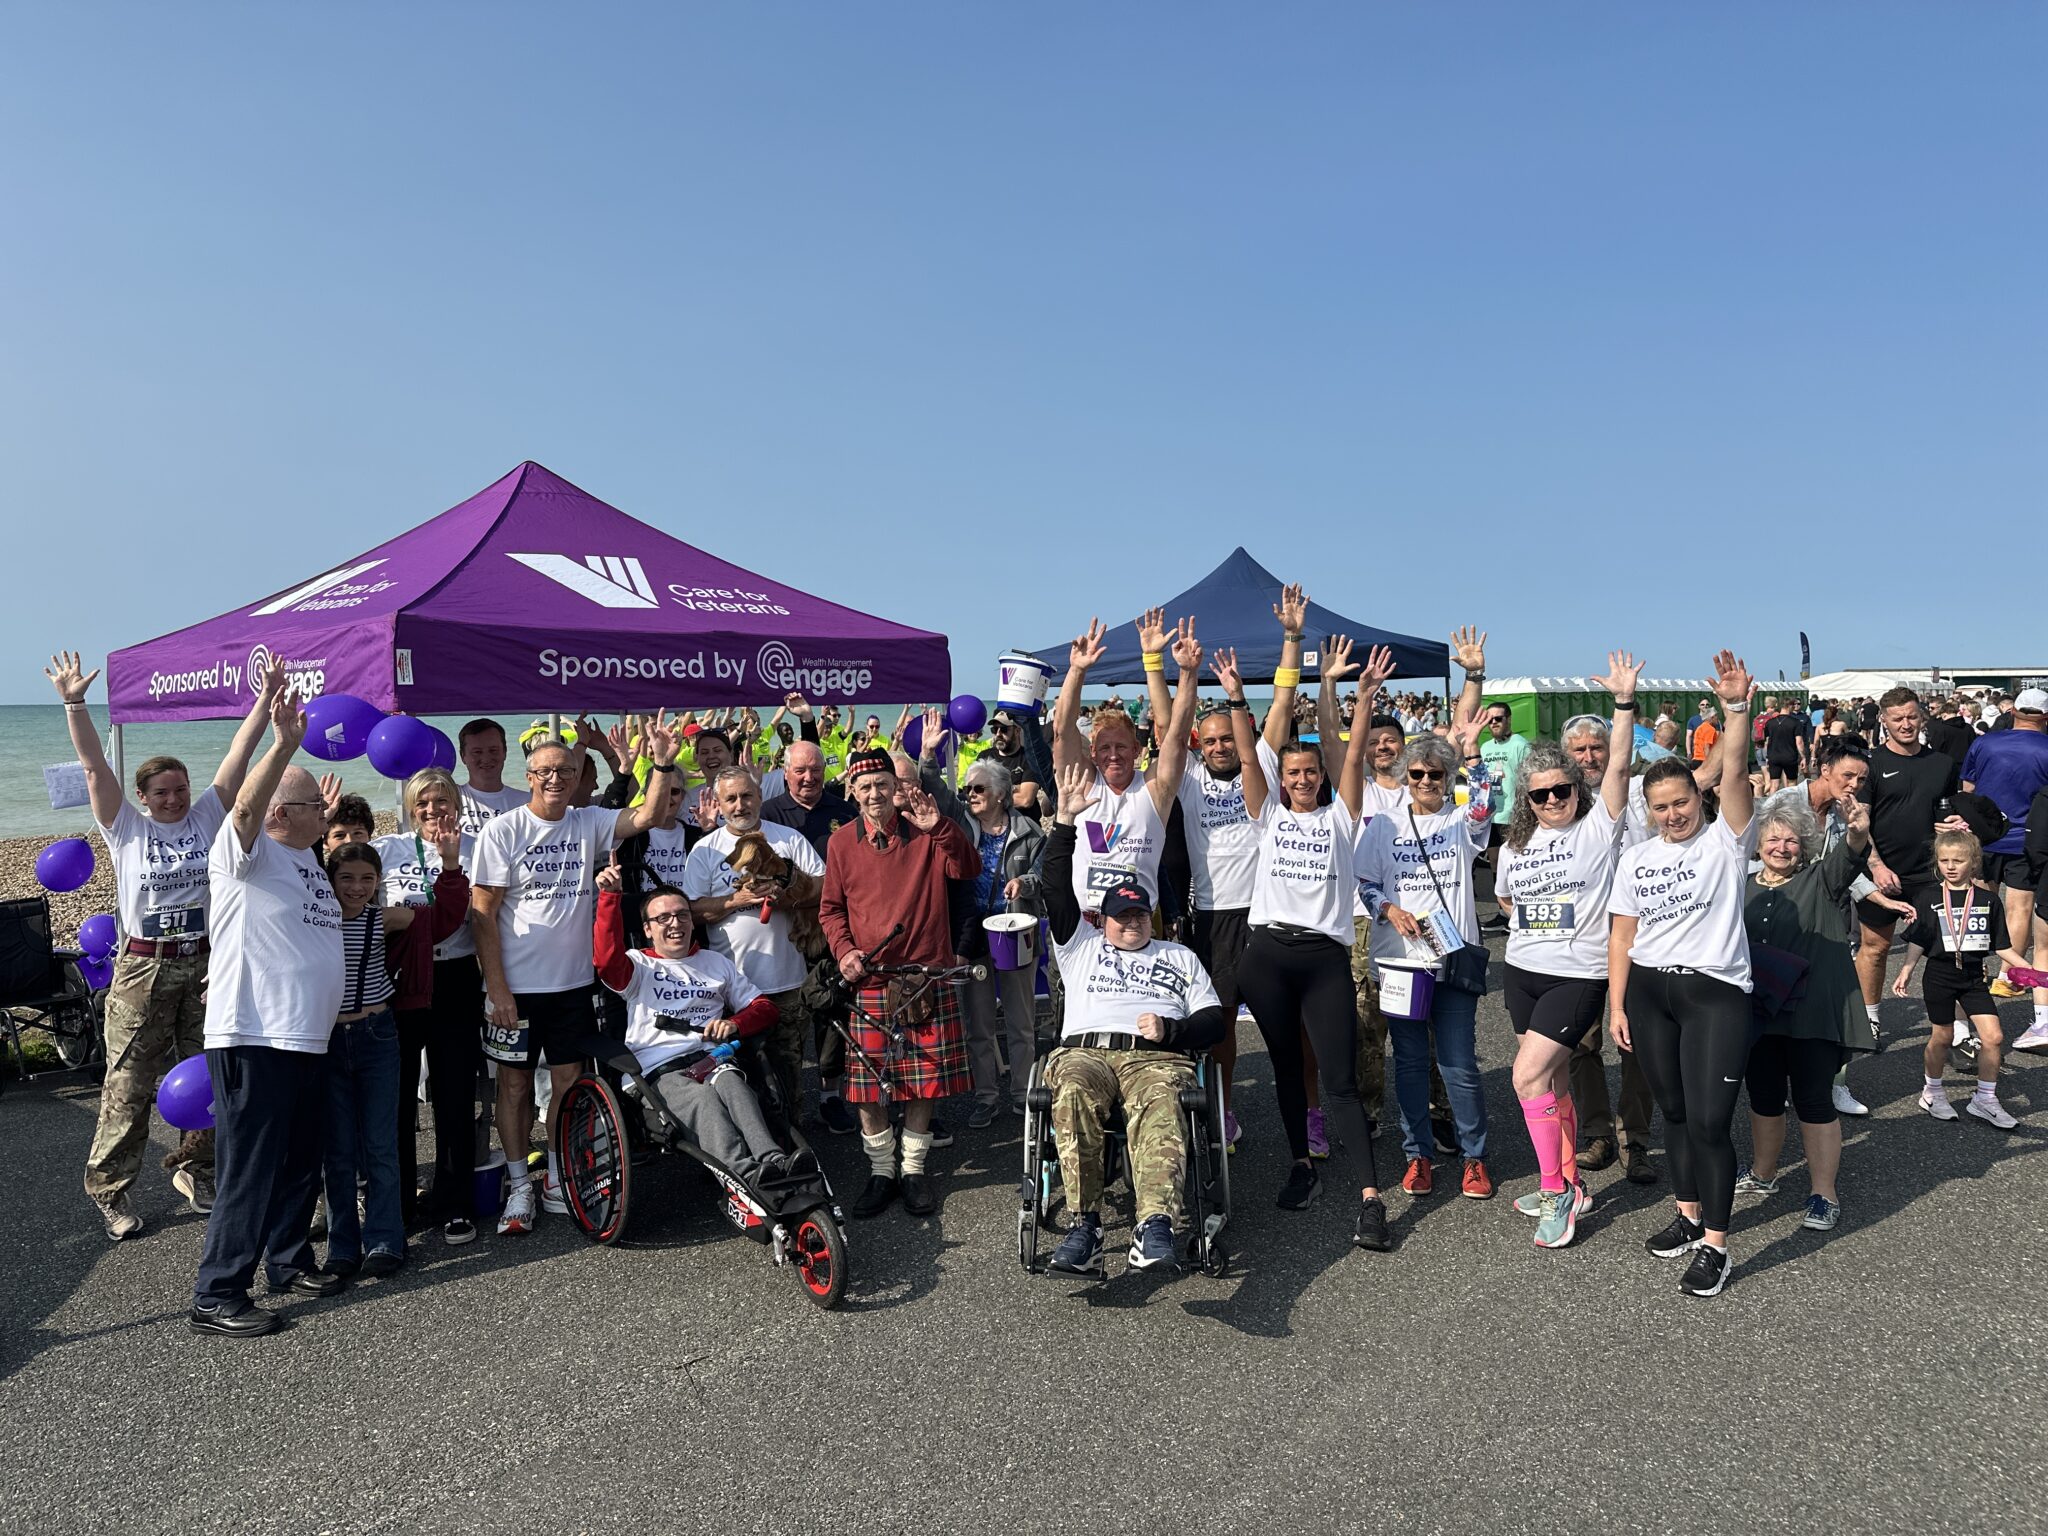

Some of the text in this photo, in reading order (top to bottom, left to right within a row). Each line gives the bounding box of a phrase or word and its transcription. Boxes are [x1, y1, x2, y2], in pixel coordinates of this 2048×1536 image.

[322, 579, 399, 597] Care for
[668, 583, 771, 602] Care for
[291, 596, 370, 612] Veterans
[671, 596, 790, 616] Veterans
[293, 657, 327, 671] Management
[538, 649, 747, 686] Sponsored by
[801, 657, 873, 669] Wealth Management
[148, 660, 242, 702] Sponsored by
[283, 669, 325, 706] gage
[779, 668, 873, 697] engage
[1012, 682, 1033, 690] Veterans
[1231, 780, 1242, 792] fo
[1208, 810, 1232, 818] Royal
[1233, 805, 1246, 814] Sta
[1200, 820, 1208, 829] &
[1208, 816, 1239, 828] Garter
[178, 834, 200, 848] for
[526, 840, 579, 855] Care for
[1120, 836, 1153, 845] Care for
[1392, 836, 1428, 848] Care
[1117, 845, 1153, 854] Veterans
[399, 863, 441, 877] Care
[523, 858, 585, 873] Veterans
[1090, 860, 1127, 870] WORTHING
[1278, 857, 1306, 869] Royal
[1308, 859, 1327, 871] Sta
[140, 872, 147, 880] a
[150, 869, 183, 881] Royal
[1270, 868, 1278, 877] &
[1278, 869, 1312, 881] Garter
[1401, 871, 1430, 882] Royal
[1514, 873, 1543, 889] Royal
[1545, 869, 1568, 881] Star
[140, 878, 210, 892] & Garter Ho
[534, 879, 562, 891] Royal
[562, 878, 581, 888] Star
[1394, 884, 1402, 892] &
[1403, 883, 1438, 892] Garter
[1554, 880, 1586, 891] Home
[1634, 868, 1697, 898] Veterns
[524, 892, 533, 902] &
[535, 889, 567, 900] Garter
[1667, 892, 1693, 905] Star
[1525, 904, 1563, 921] 593
[1680, 900, 1713, 916] Home
[159, 910, 188, 929] 511
[1528, 921, 1561, 929] TIFFANY
[163, 926, 186, 936] KATE
[1102, 943, 1151, 975] Ca for
[1097, 953, 1150, 987] Veteran
[1098, 974, 1126, 988] Royal
[1397, 984, 1406, 992] for
[653, 987, 717, 1001] Veterans
[1086, 984, 1095, 993] &
[1384, 988, 1406, 997] Veterans
[661, 1006, 689, 1018] Royal
[689, 1006, 710, 1014] Star
